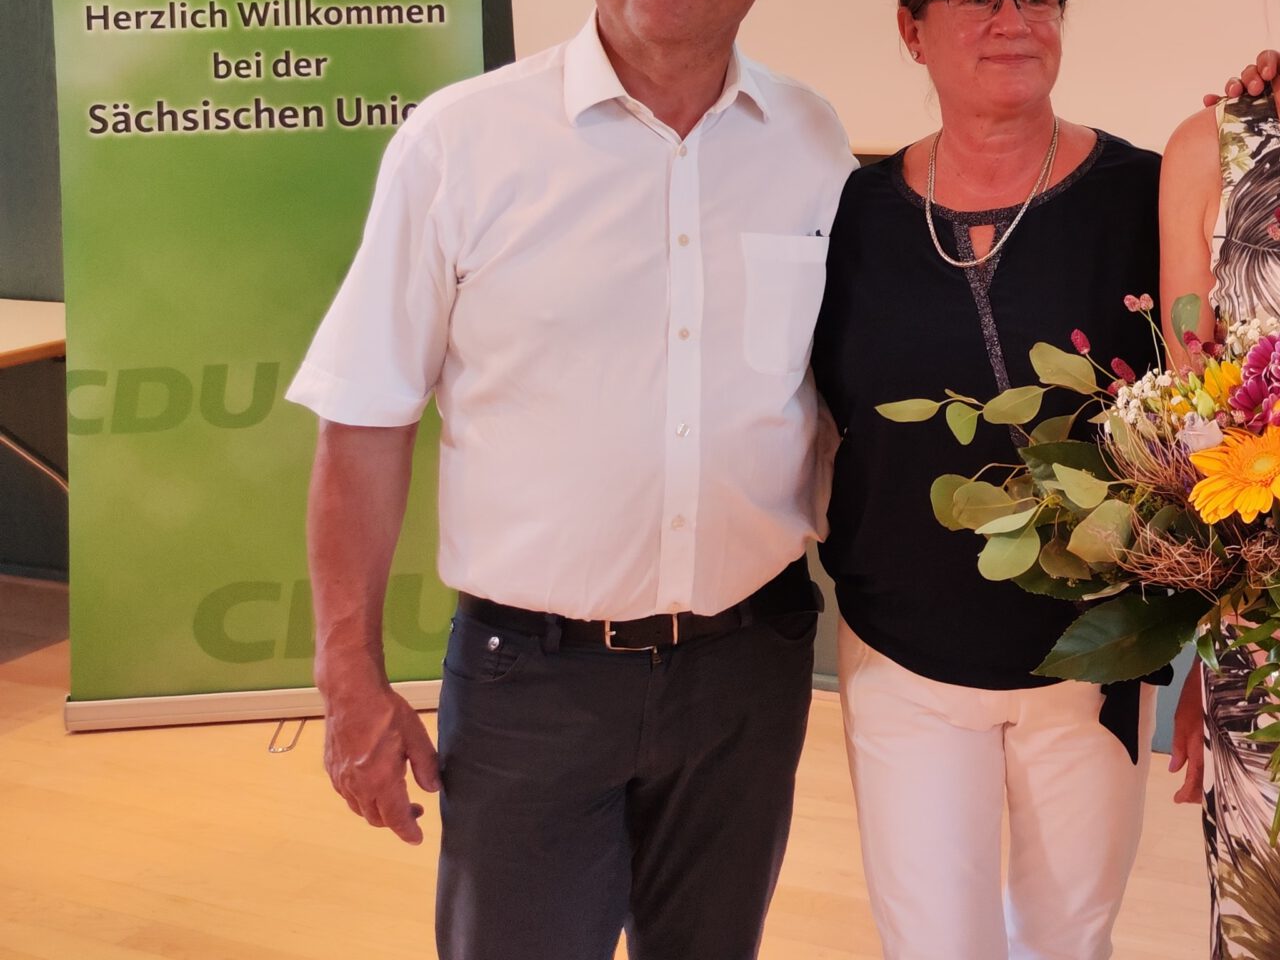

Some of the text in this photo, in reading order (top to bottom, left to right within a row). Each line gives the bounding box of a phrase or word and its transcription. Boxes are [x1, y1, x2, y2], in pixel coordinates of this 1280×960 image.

[85, 1, 229, 31] Herzlich
[212, 50, 328, 79] bei der
[88, 95, 418, 136] Sächsischen Uni
[67, 362, 280, 435] CDU
[193, 573, 460, 664] CU
